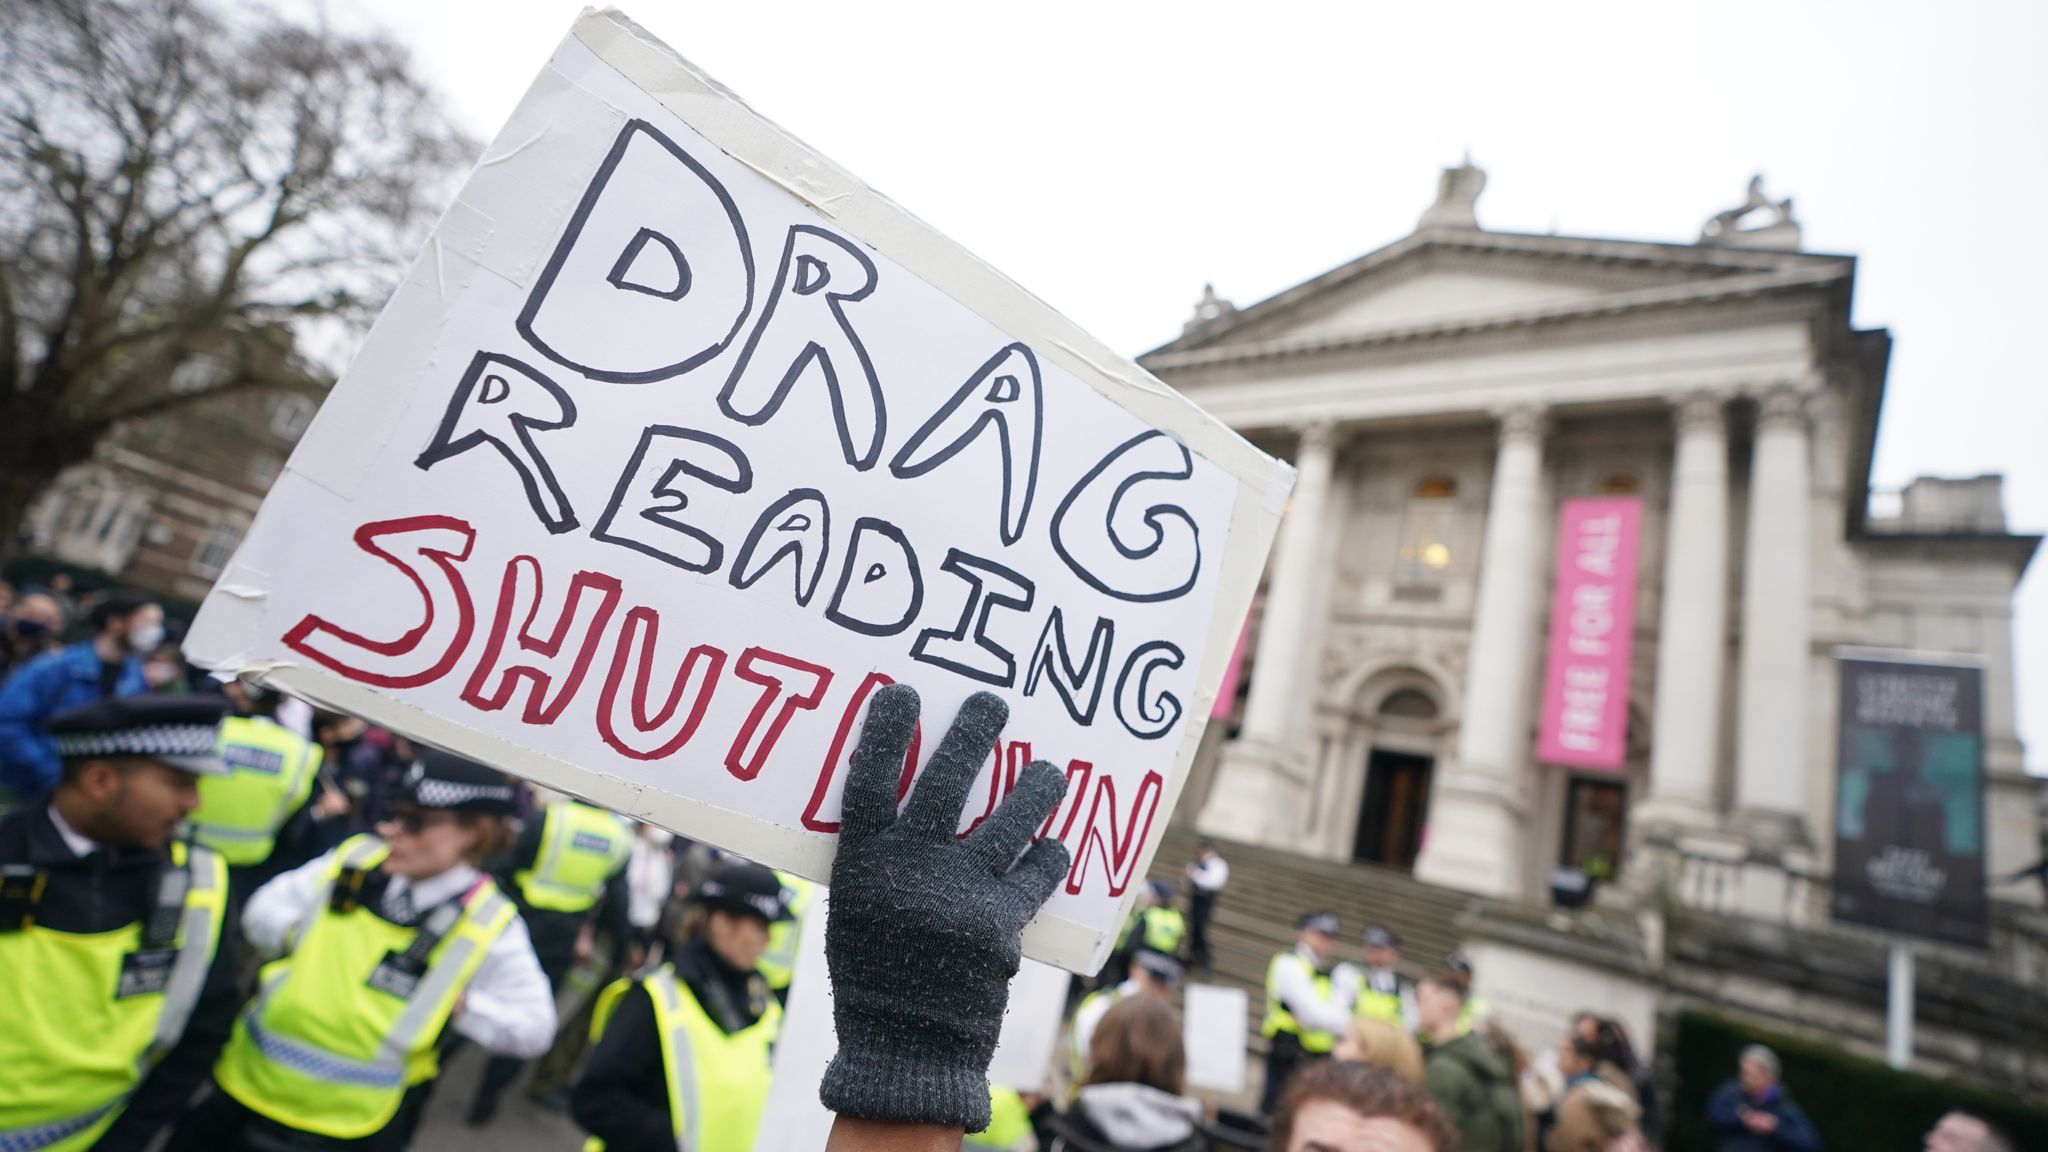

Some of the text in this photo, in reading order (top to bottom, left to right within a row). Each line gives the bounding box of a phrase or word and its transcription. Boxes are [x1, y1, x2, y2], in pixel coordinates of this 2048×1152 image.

[414, 350, 1185, 740] READING
[516, 118, 1201, 602] DRAG
[1559, 513, 1621, 751] FREE FOR ALL
